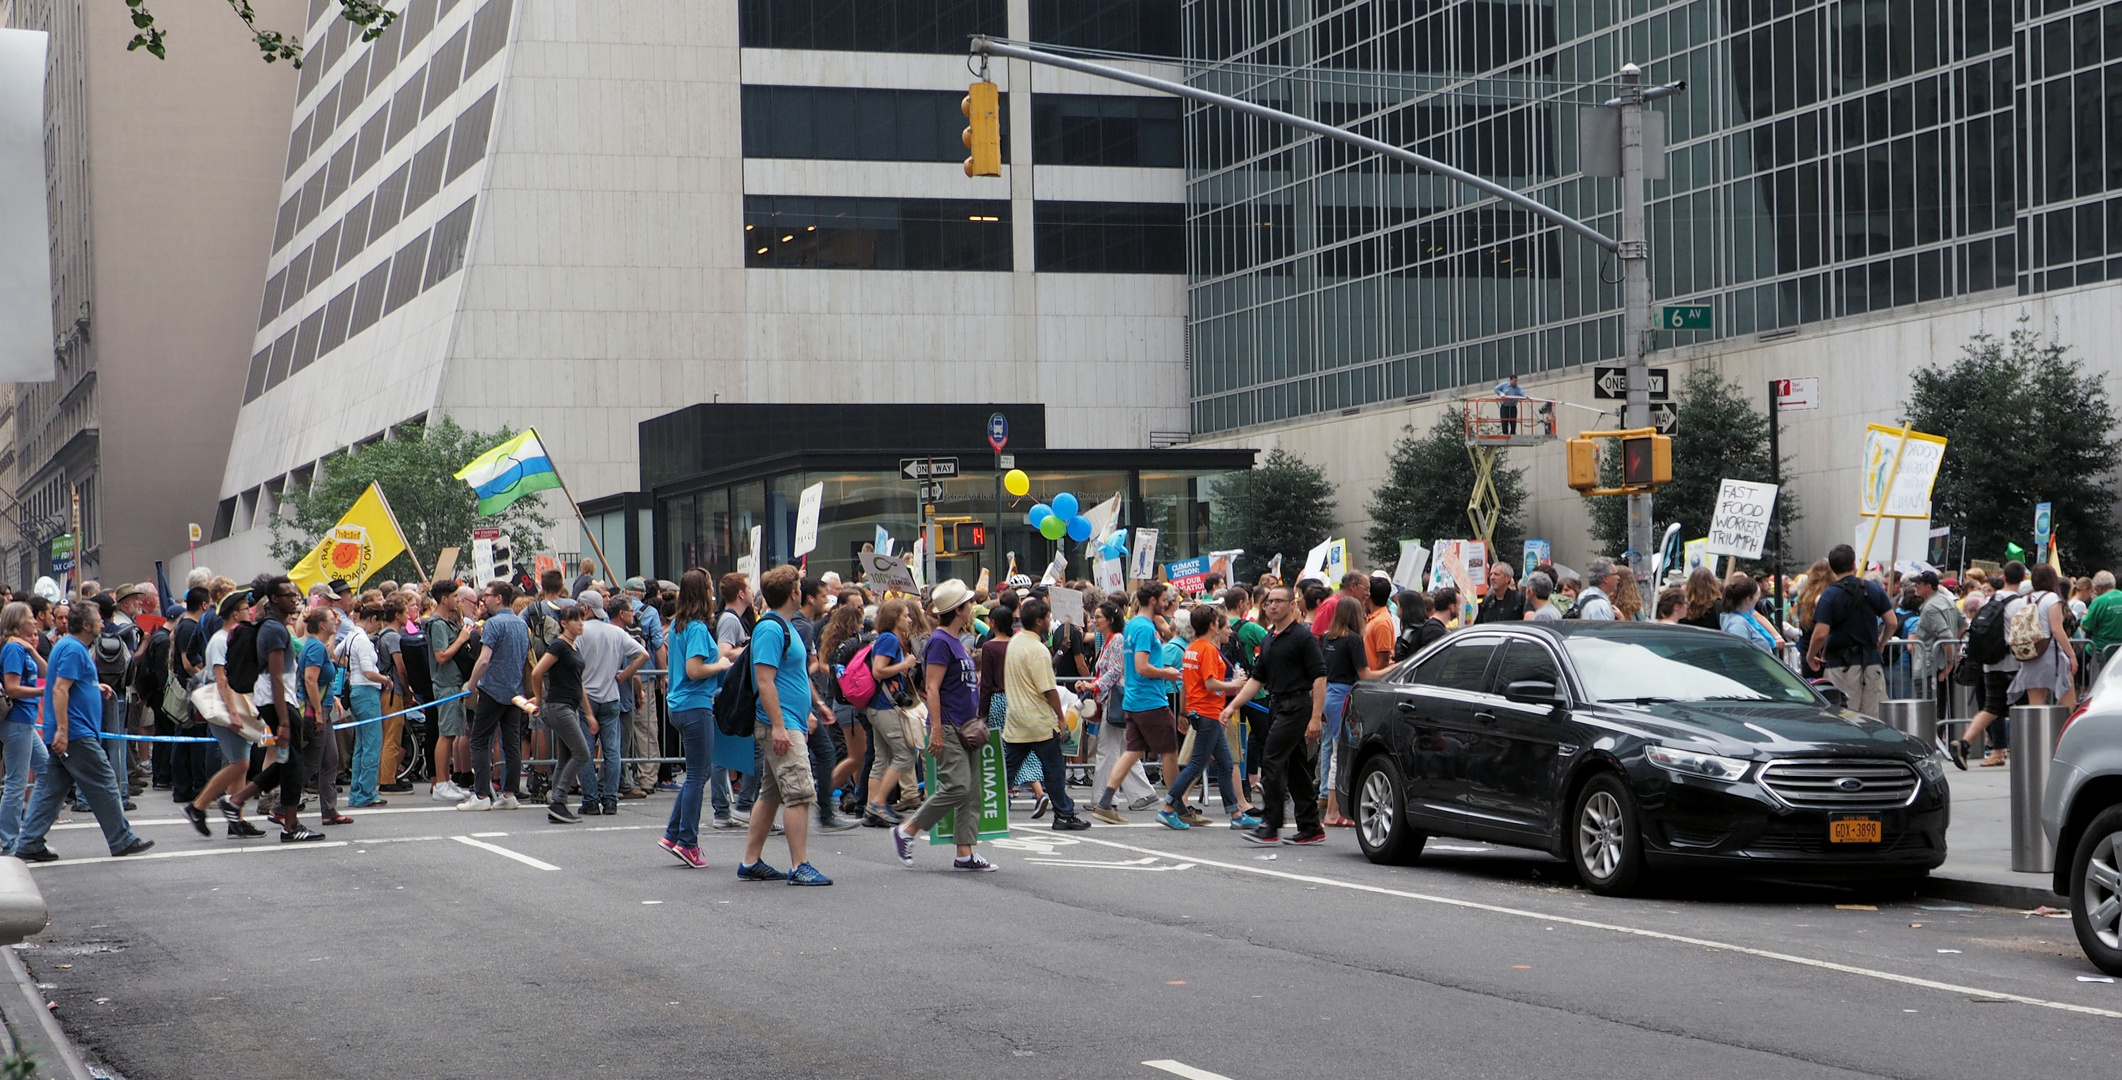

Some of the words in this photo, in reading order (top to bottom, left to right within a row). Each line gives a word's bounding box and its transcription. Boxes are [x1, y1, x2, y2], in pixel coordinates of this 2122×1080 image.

[1671, 309, 1684, 328] 6
[1688, 308, 1702, 319] AV
[1605, 377, 1626, 390] ONE
[1654, 412, 1672, 425] WAY
[916, 465, 928, 474] ON
[936, 464, 952, 473] WAY
[1723, 485, 1759, 499] FAST
[1722, 501, 1764, 517] FOOD
[1715, 514, 1765, 538] WORKERS
[973, 527, 984, 545] 14
[1712, 530, 1759, 552] TRIUMPH
[63, 559, 76, 570] CARBO
[1171, 560, 1200, 572] CLIMATE
[871, 573, 891, 585] 100%
[1173, 567, 1200, 578] ACTION:
[1109, 572, 1122, 587] NOW
[1173, 579, 1185, 588] IT'S
[1186, 576, 1201, 585] OUR
[982, 743, 998, 819] CLIMATE
